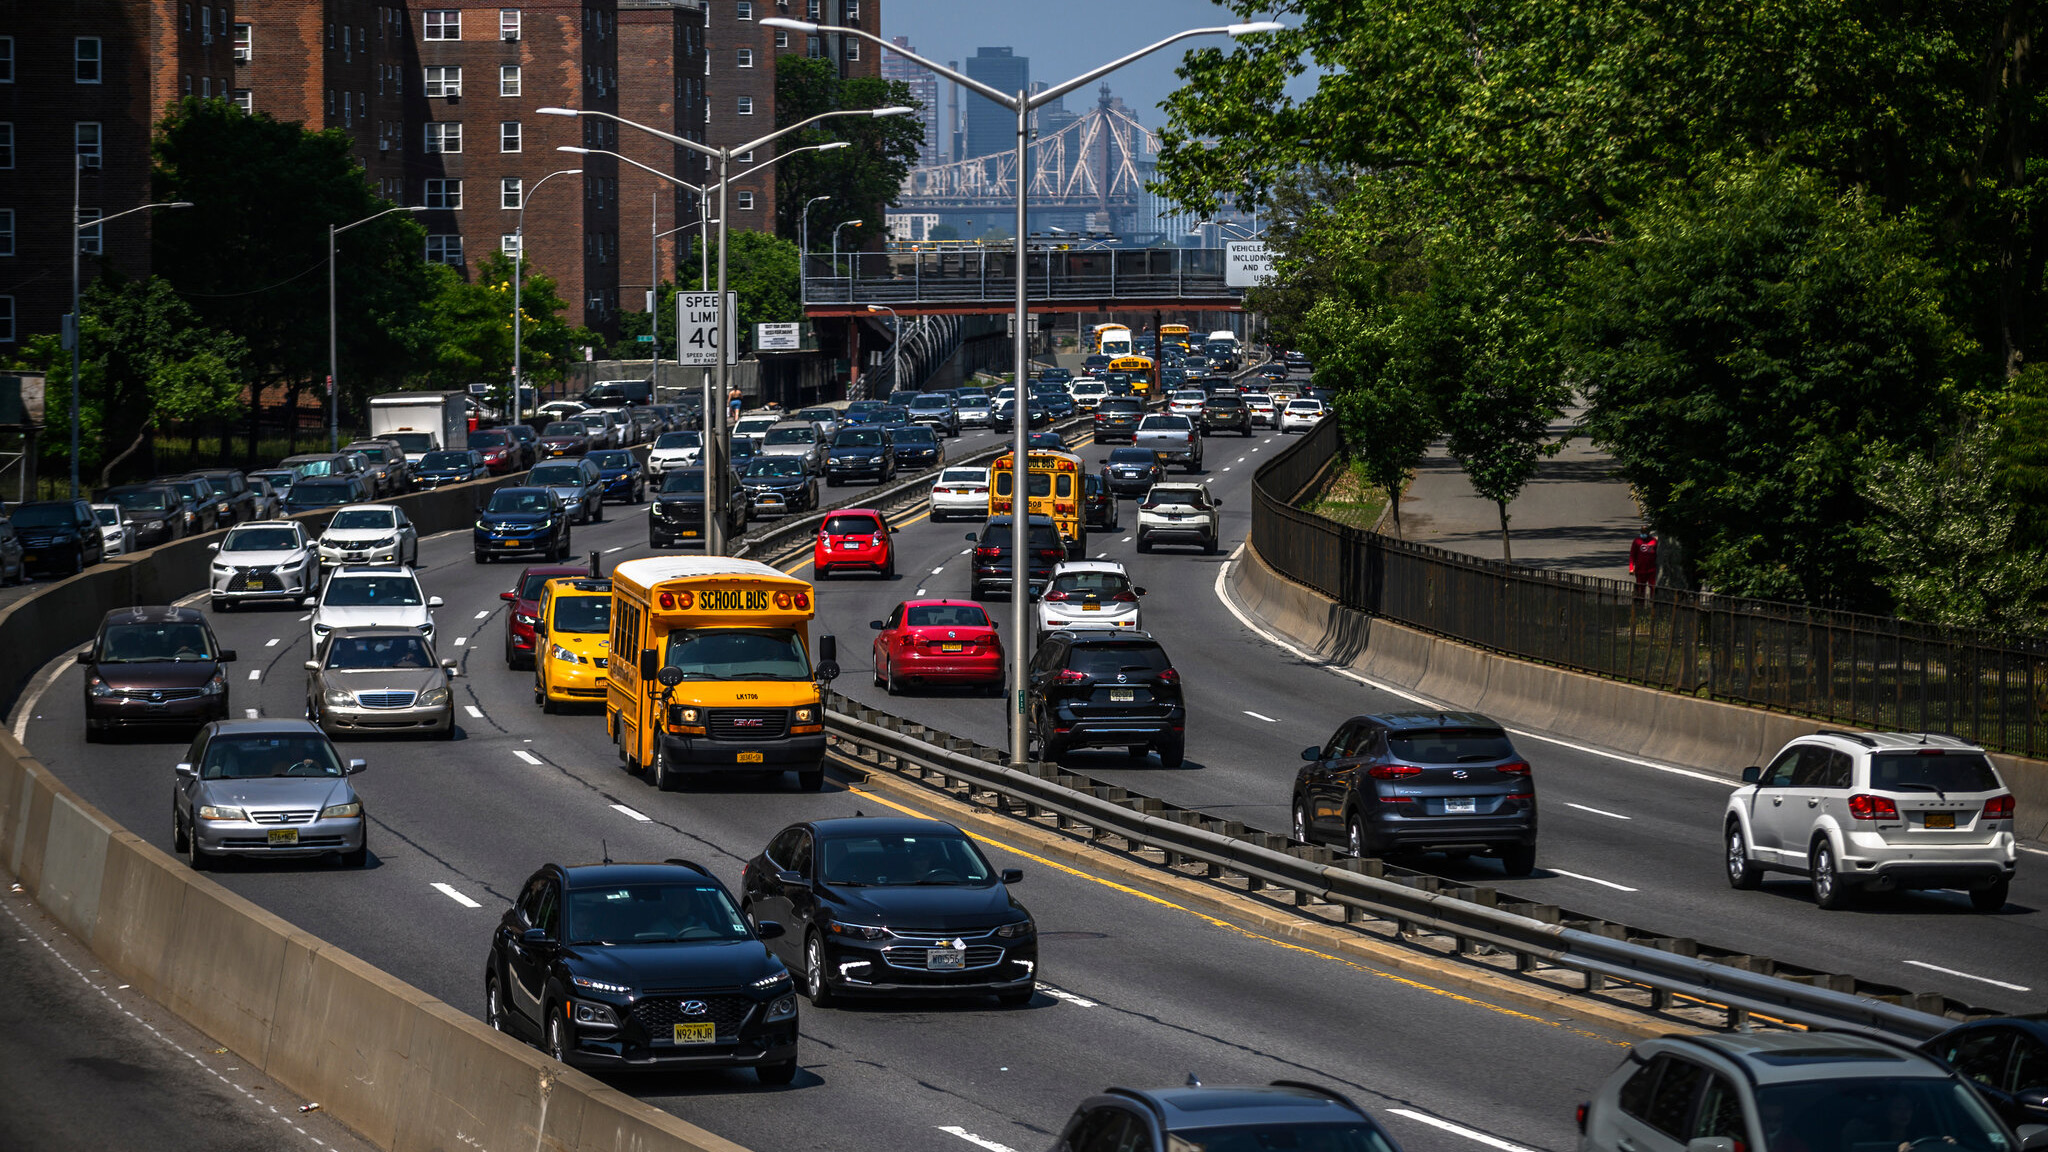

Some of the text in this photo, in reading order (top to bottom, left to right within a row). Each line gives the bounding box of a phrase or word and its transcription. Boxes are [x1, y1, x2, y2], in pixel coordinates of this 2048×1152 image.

[1233, 254, 1272, 262] INCLUDING
[686, 296, 719, 308] SPEE
[690, 311, 719, 323] LIMI
[1042, 459, 1055, 468] BUS
[700, 591, 768, 609] SCHOOL BUS
[734, 718, 763, 727] GMC
